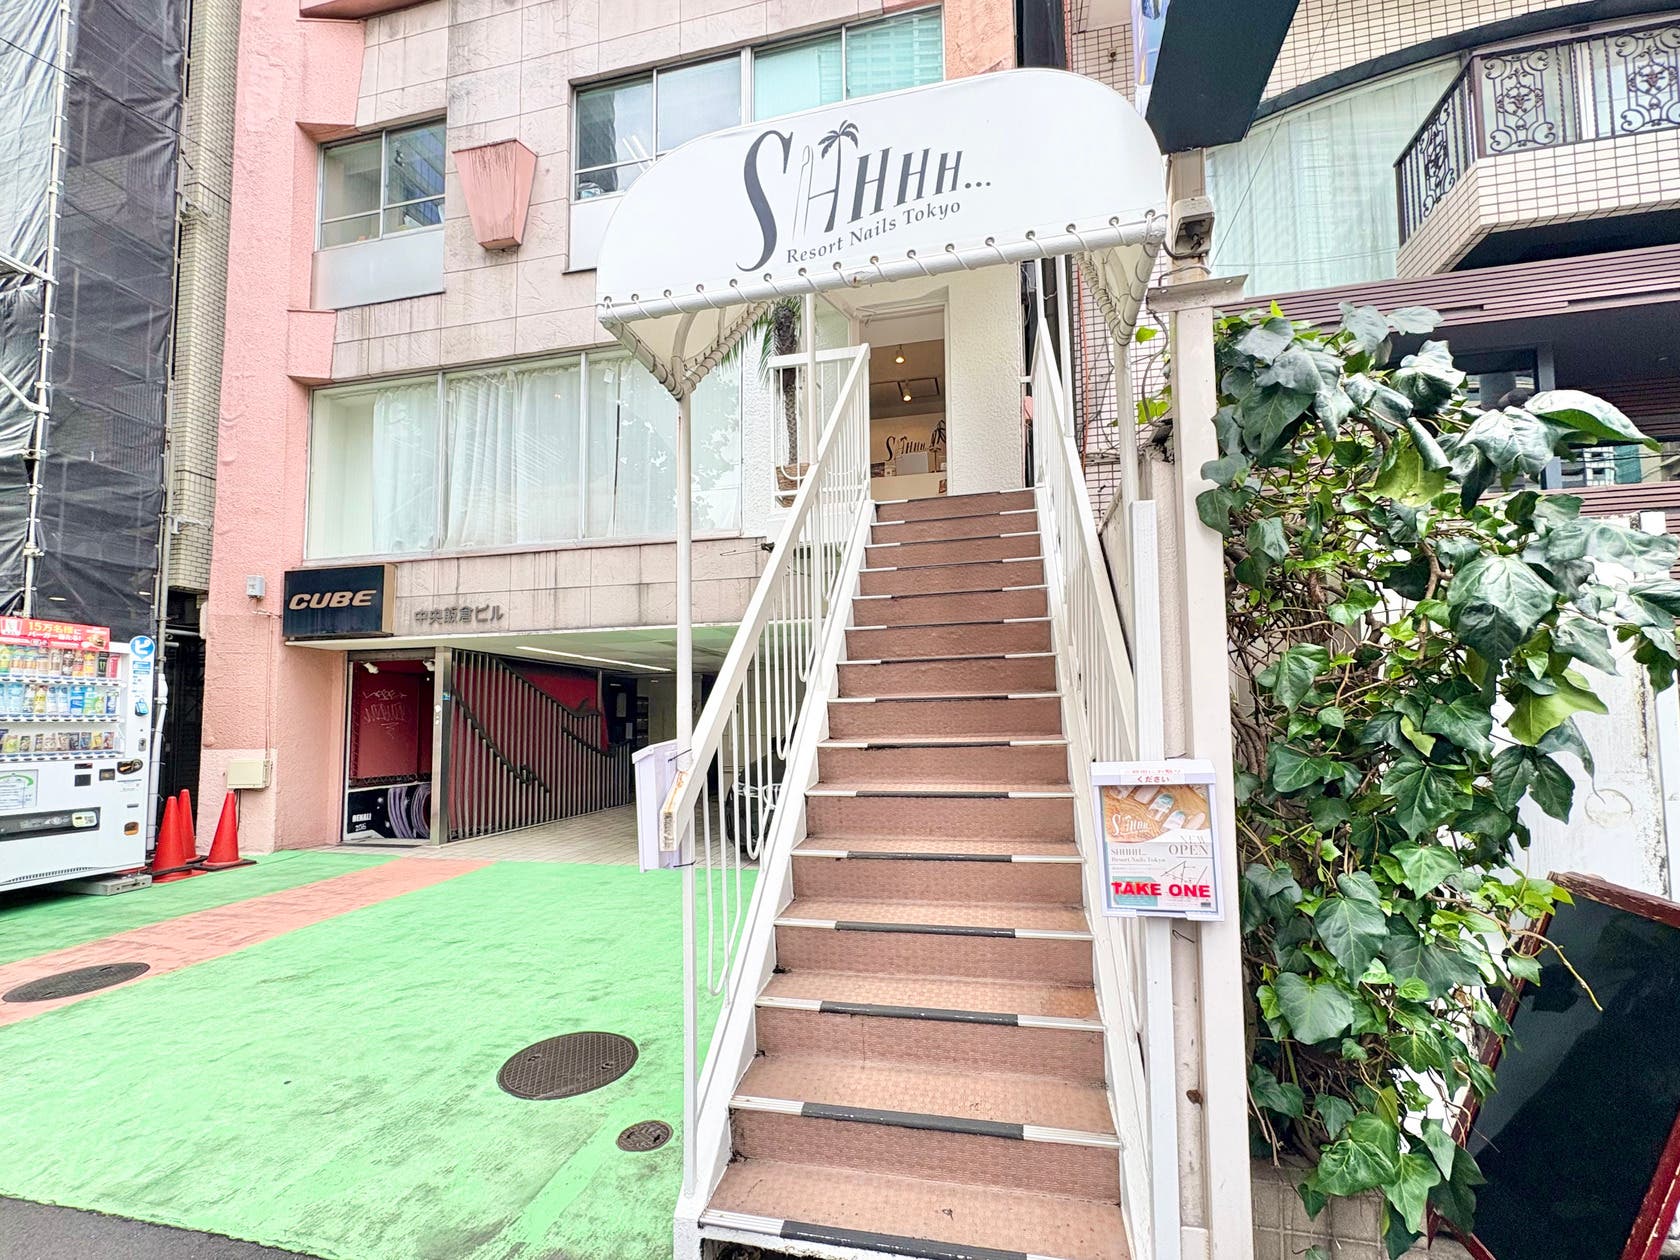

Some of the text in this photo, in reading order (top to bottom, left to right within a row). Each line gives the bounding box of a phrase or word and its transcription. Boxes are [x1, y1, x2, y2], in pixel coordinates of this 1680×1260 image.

[786, 201, 961, 264] Resort Nails Tokyo
[288, 590, 377, 610] CUBE
[414, 604, 504, 625] 中央飯倉ビル
[1169, 844, 1208, 855] OPEN
[1111, 881, 1211, 898] TAKE ONE
